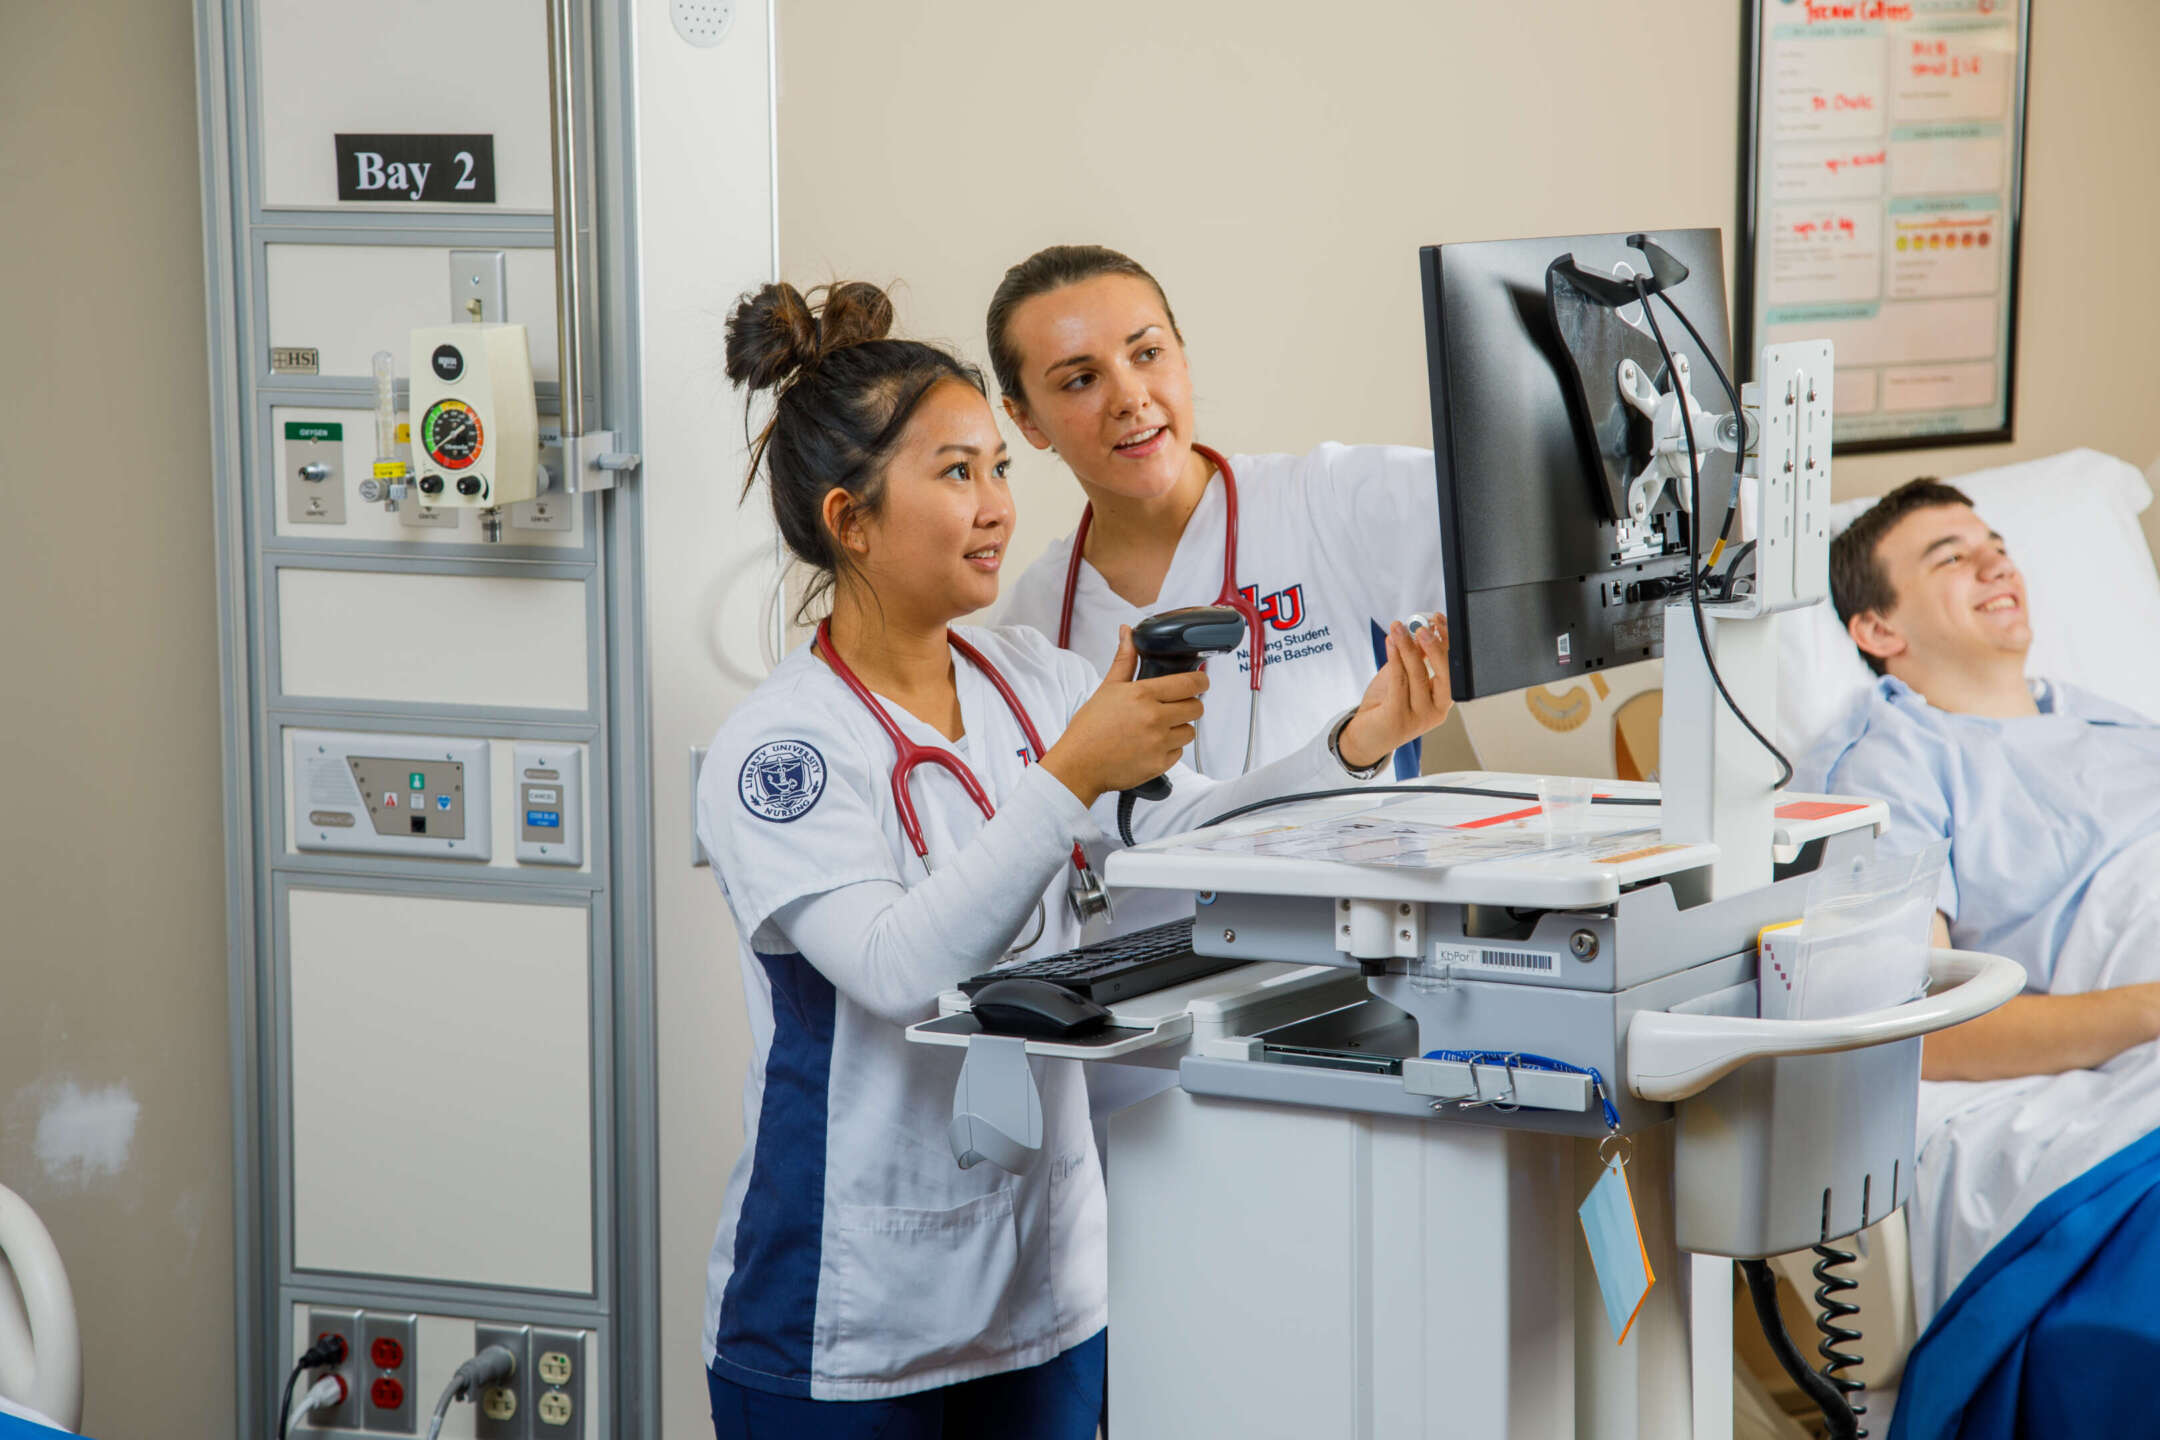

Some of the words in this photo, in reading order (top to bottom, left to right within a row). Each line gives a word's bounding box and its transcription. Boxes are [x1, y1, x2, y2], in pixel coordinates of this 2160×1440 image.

[353, 152, 432, 200] Bay
[453, 151, 477, 190] 2
[288, 351, 316, 366] HSI
[1283, 626, 1330, 646] Student
[1283, 642, 1333, 661] Bashore
[744, 750, 767, 789] LIBERTY
[772, 743, 822, 774] UNIVERSITY
[764, 799, 811, 817] NURSING
